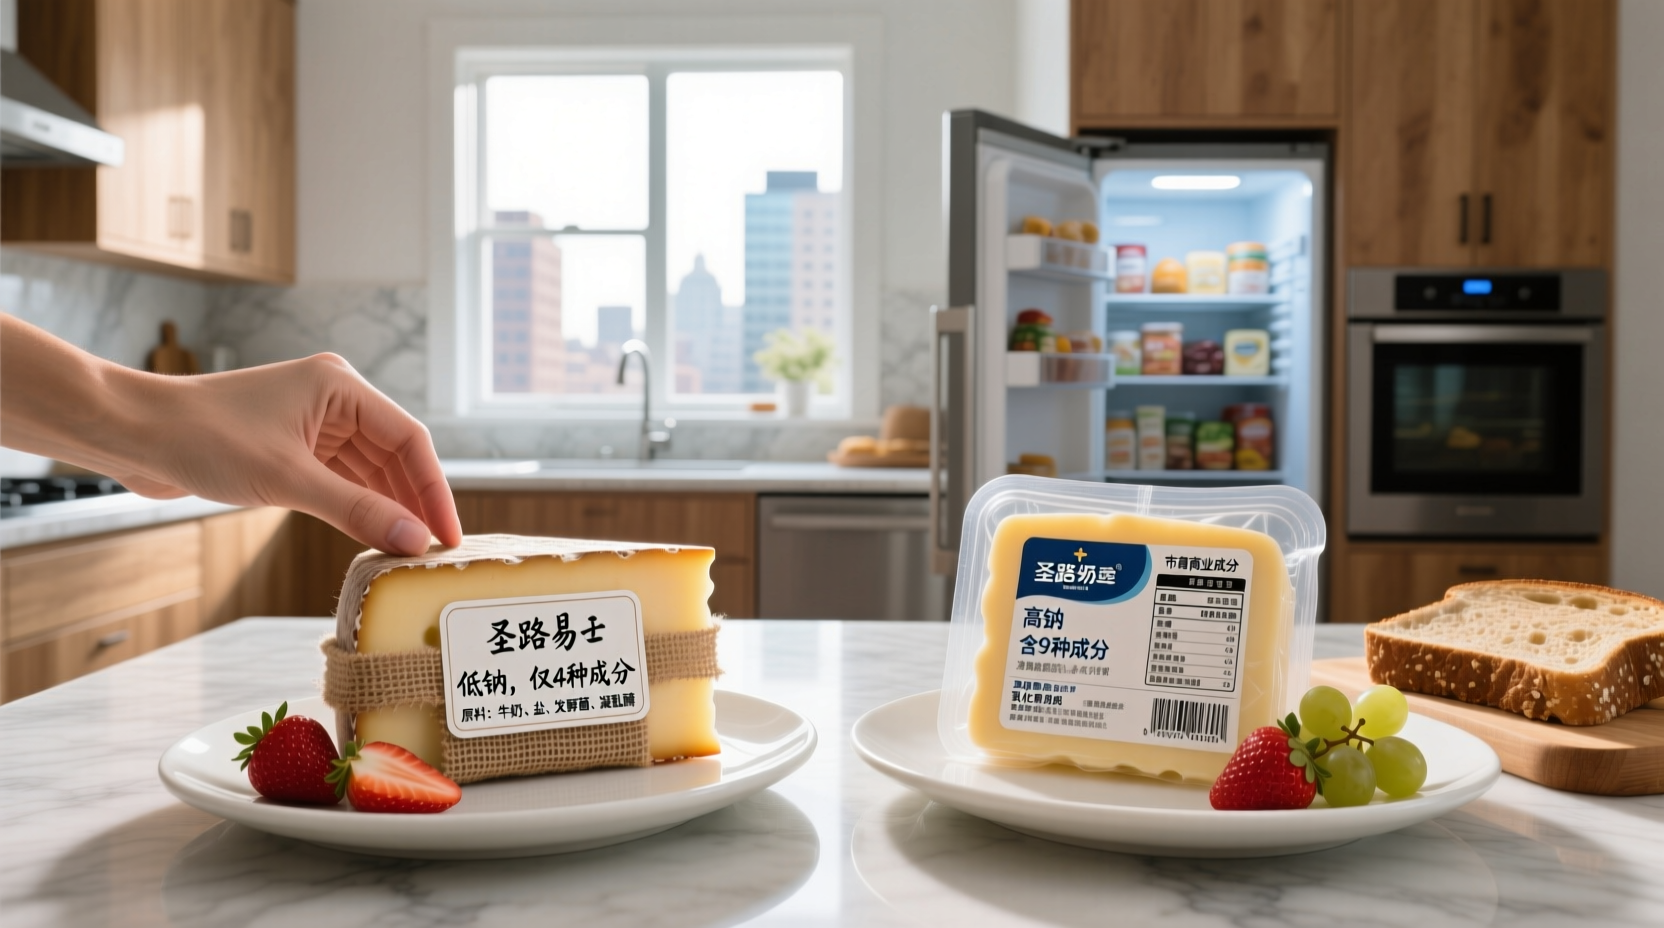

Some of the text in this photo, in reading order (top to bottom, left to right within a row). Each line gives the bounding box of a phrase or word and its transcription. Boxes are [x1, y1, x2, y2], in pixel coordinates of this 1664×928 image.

[1023, 606, 1064, 630] 高钠
[1019, 634, 1110, 661] 含9种成分
